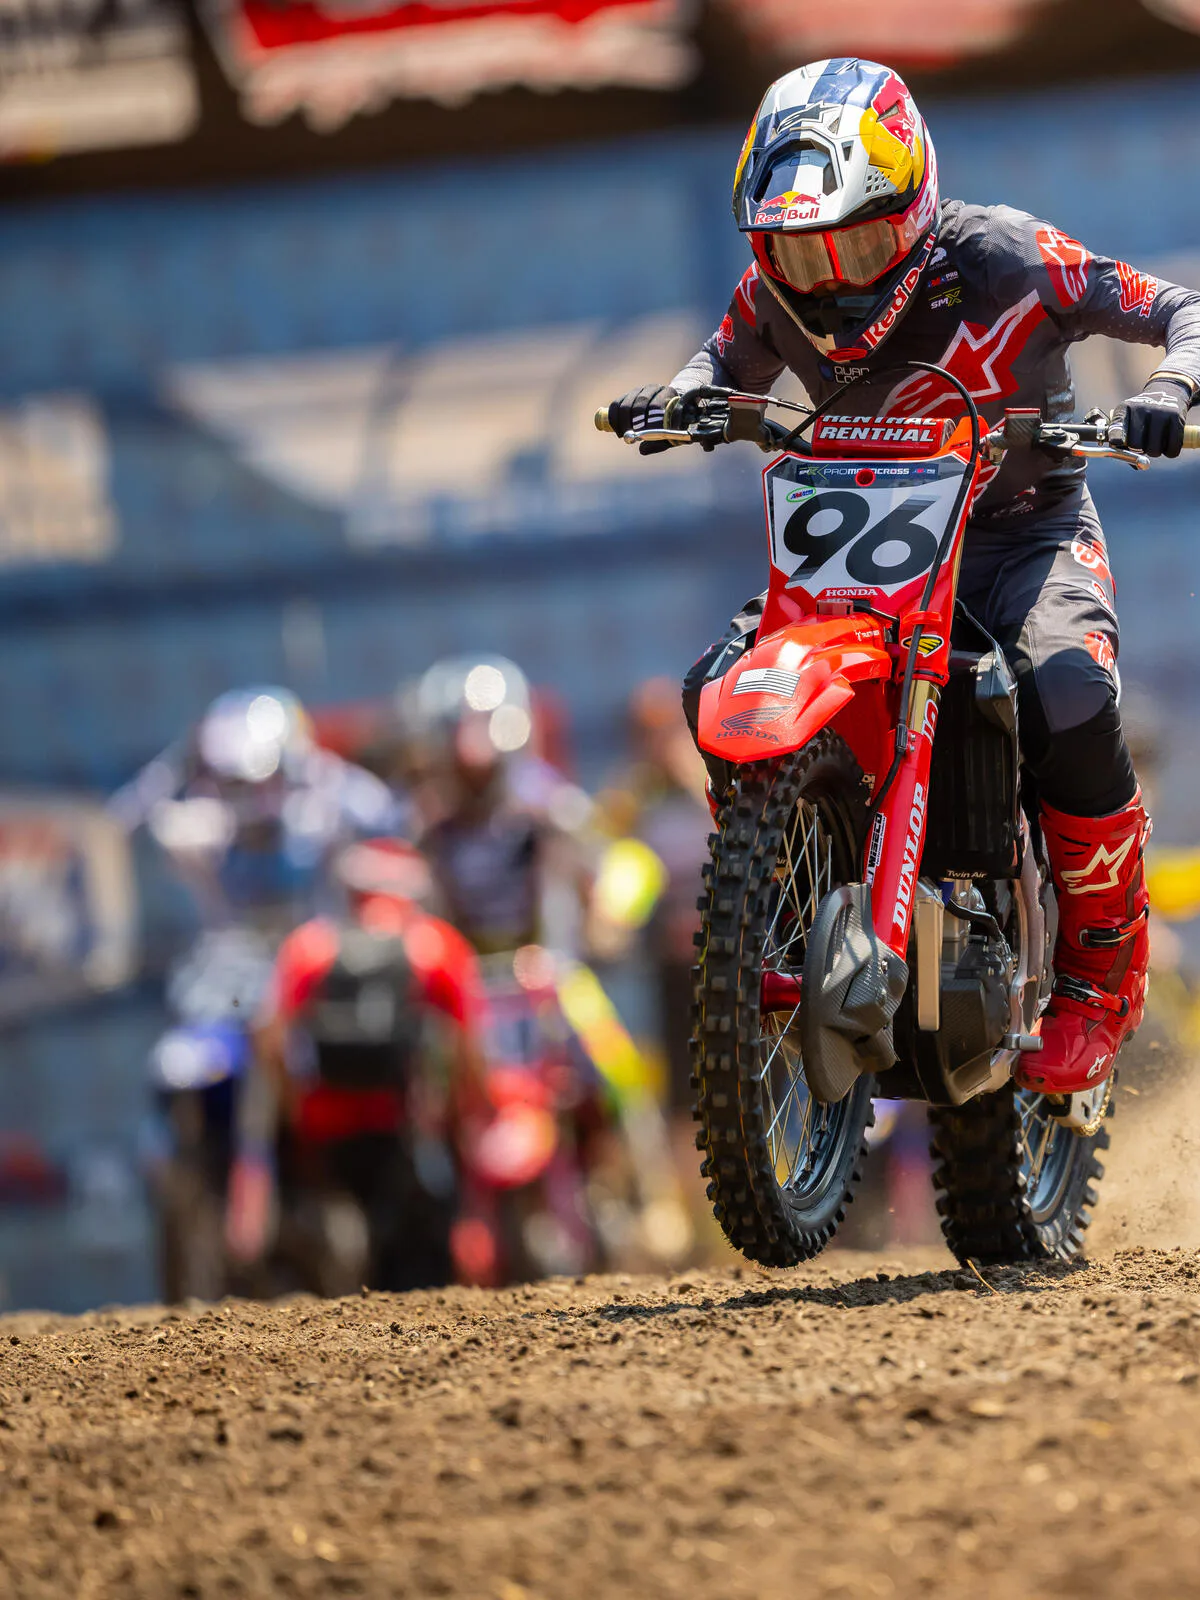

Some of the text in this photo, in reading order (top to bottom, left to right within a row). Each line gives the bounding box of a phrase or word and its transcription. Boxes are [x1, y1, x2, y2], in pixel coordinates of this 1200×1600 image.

[755, 207, 820, 225] Red Bull
[1138, 274, 1158, 318] HON
[862, 284, 909, 349] Red
[834, 374, 872, 385] LO
[819, 426, 934, 442] RENTHAL
[783, 491, 940, 588] 96
[825, 588, 878, 597] HONDA
[715, 730, 780, 743] HONDA
[892, 782, 925, 934] DUNLOP
[946, 870, 987, 879] Twin Air
